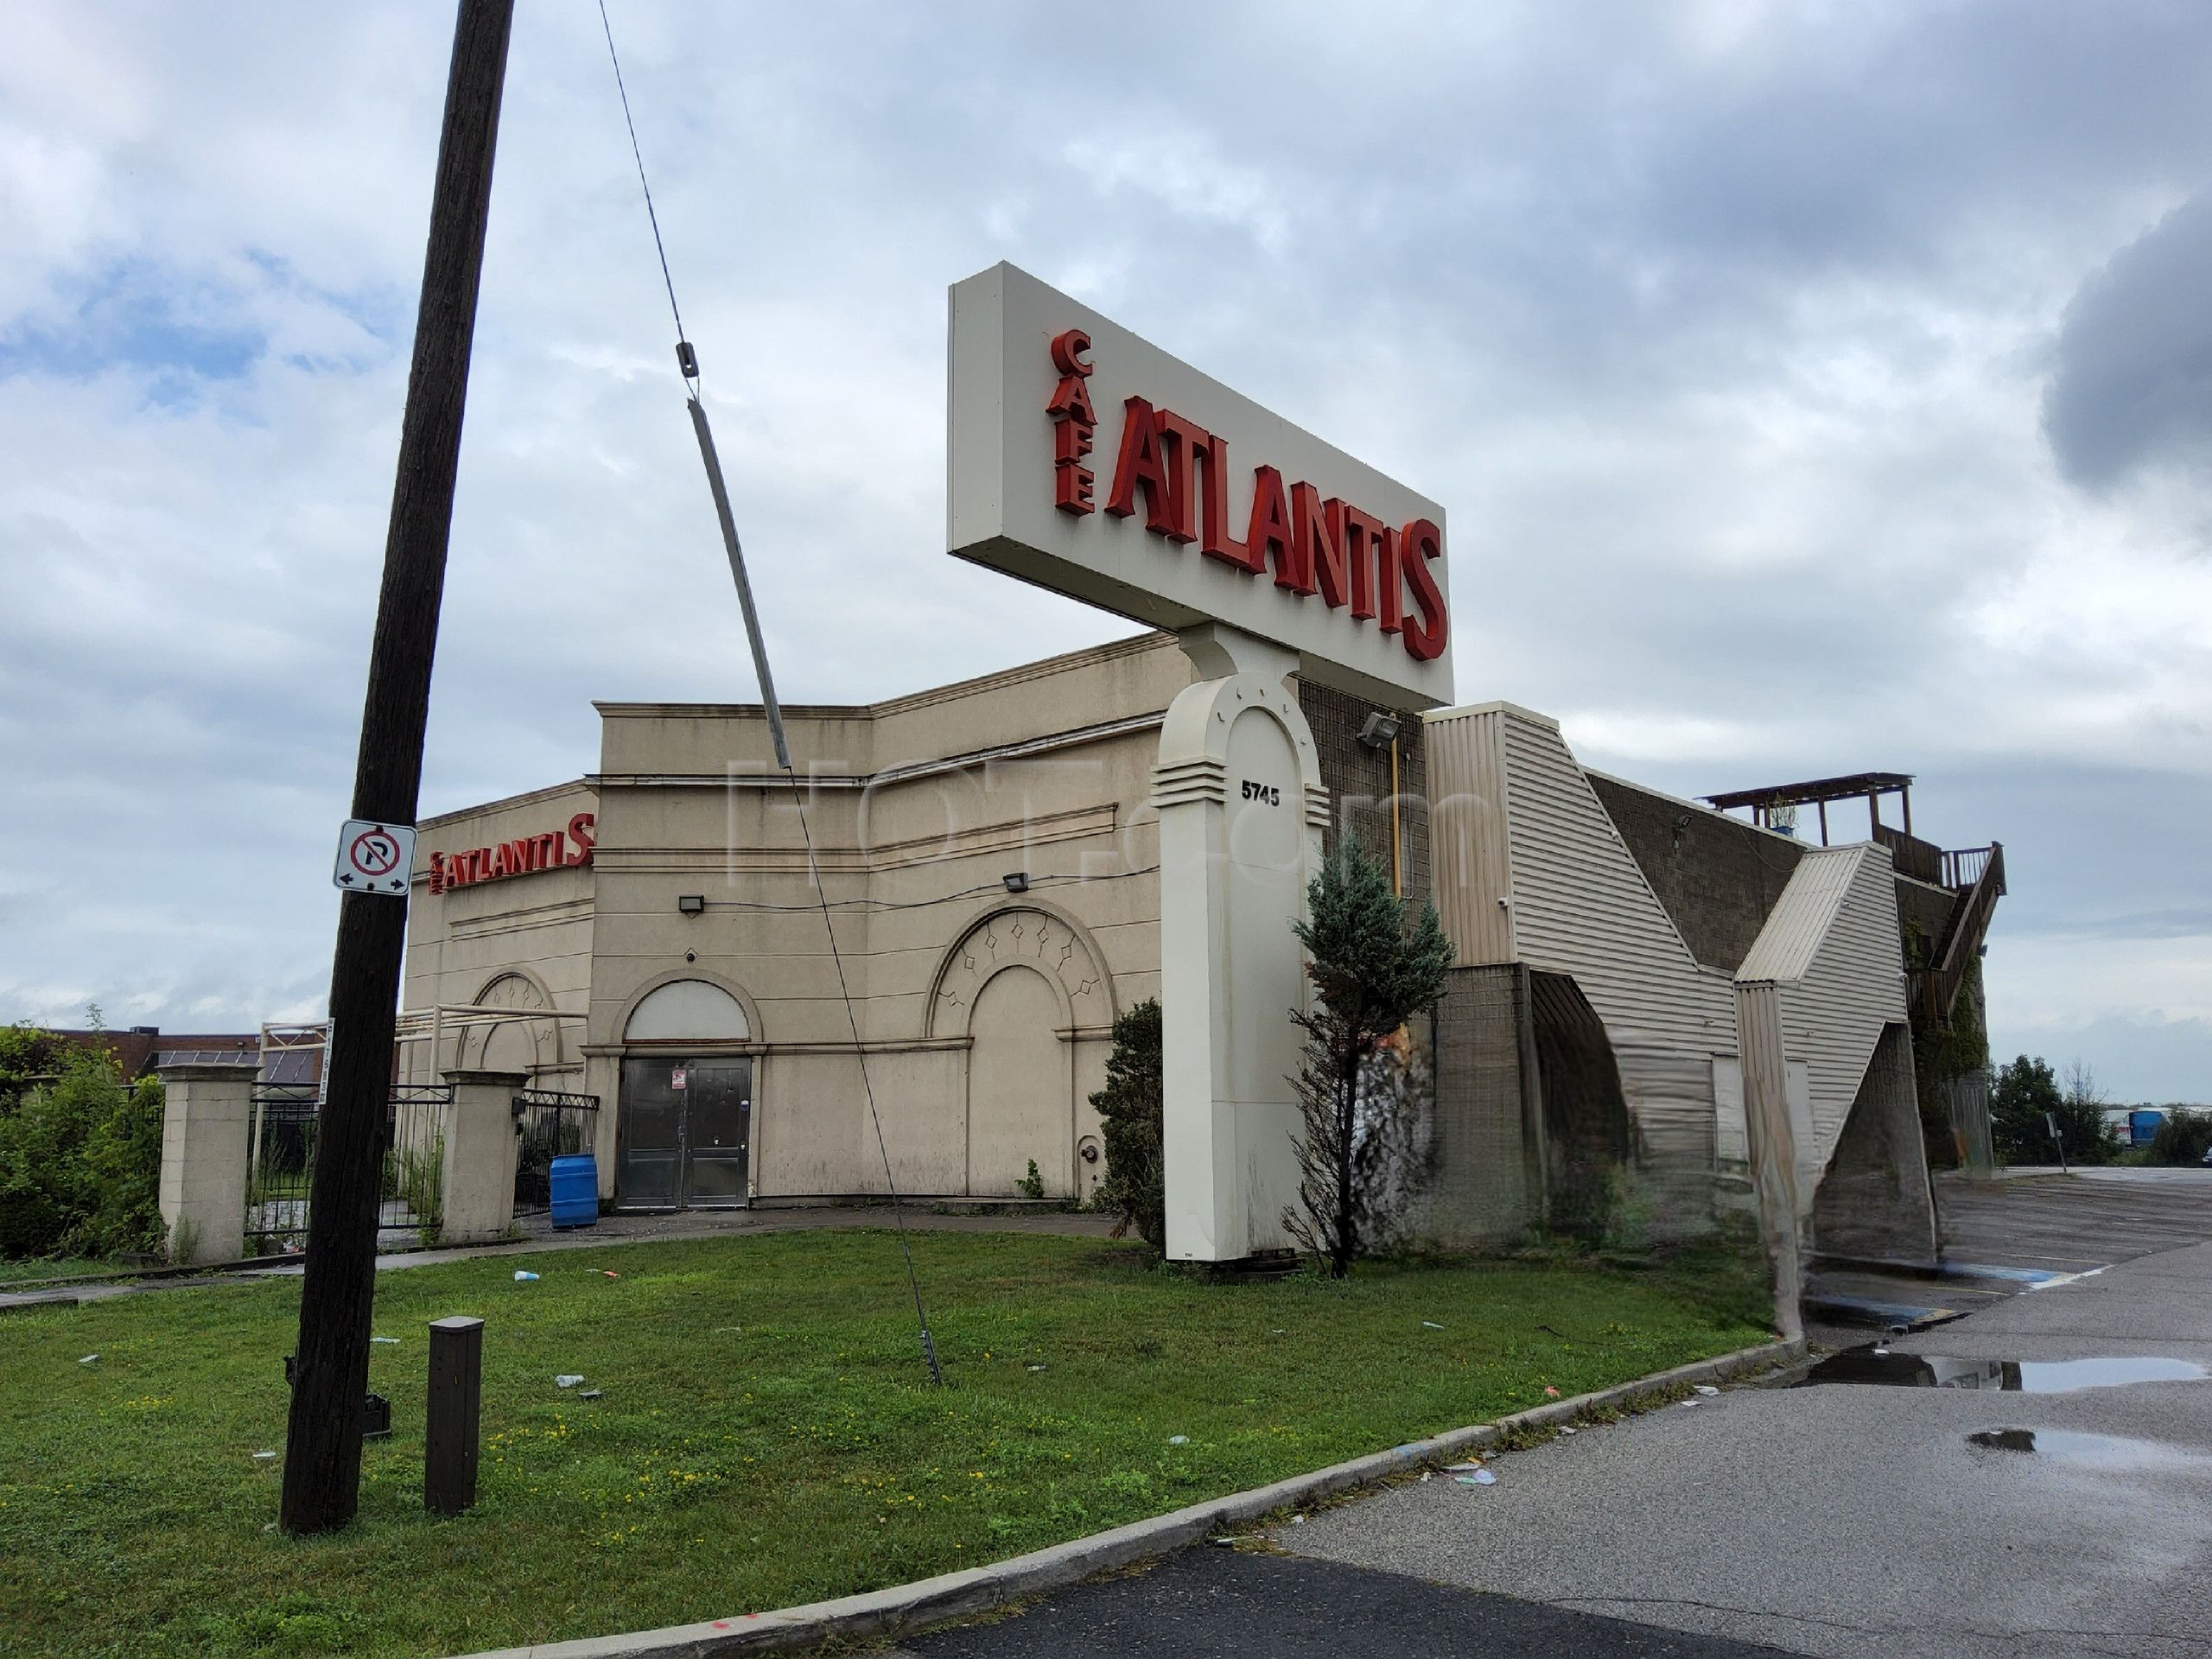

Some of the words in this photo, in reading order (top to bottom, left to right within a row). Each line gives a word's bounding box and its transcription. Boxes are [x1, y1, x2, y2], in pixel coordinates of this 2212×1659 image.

[1046, 328, 1098, 517] CAFE
[1103, 395, 1448, 662] ATLANTIS
[442, 812, 595, 887] ATLANTIS
[1241, 779, 1280, 807] 5745
